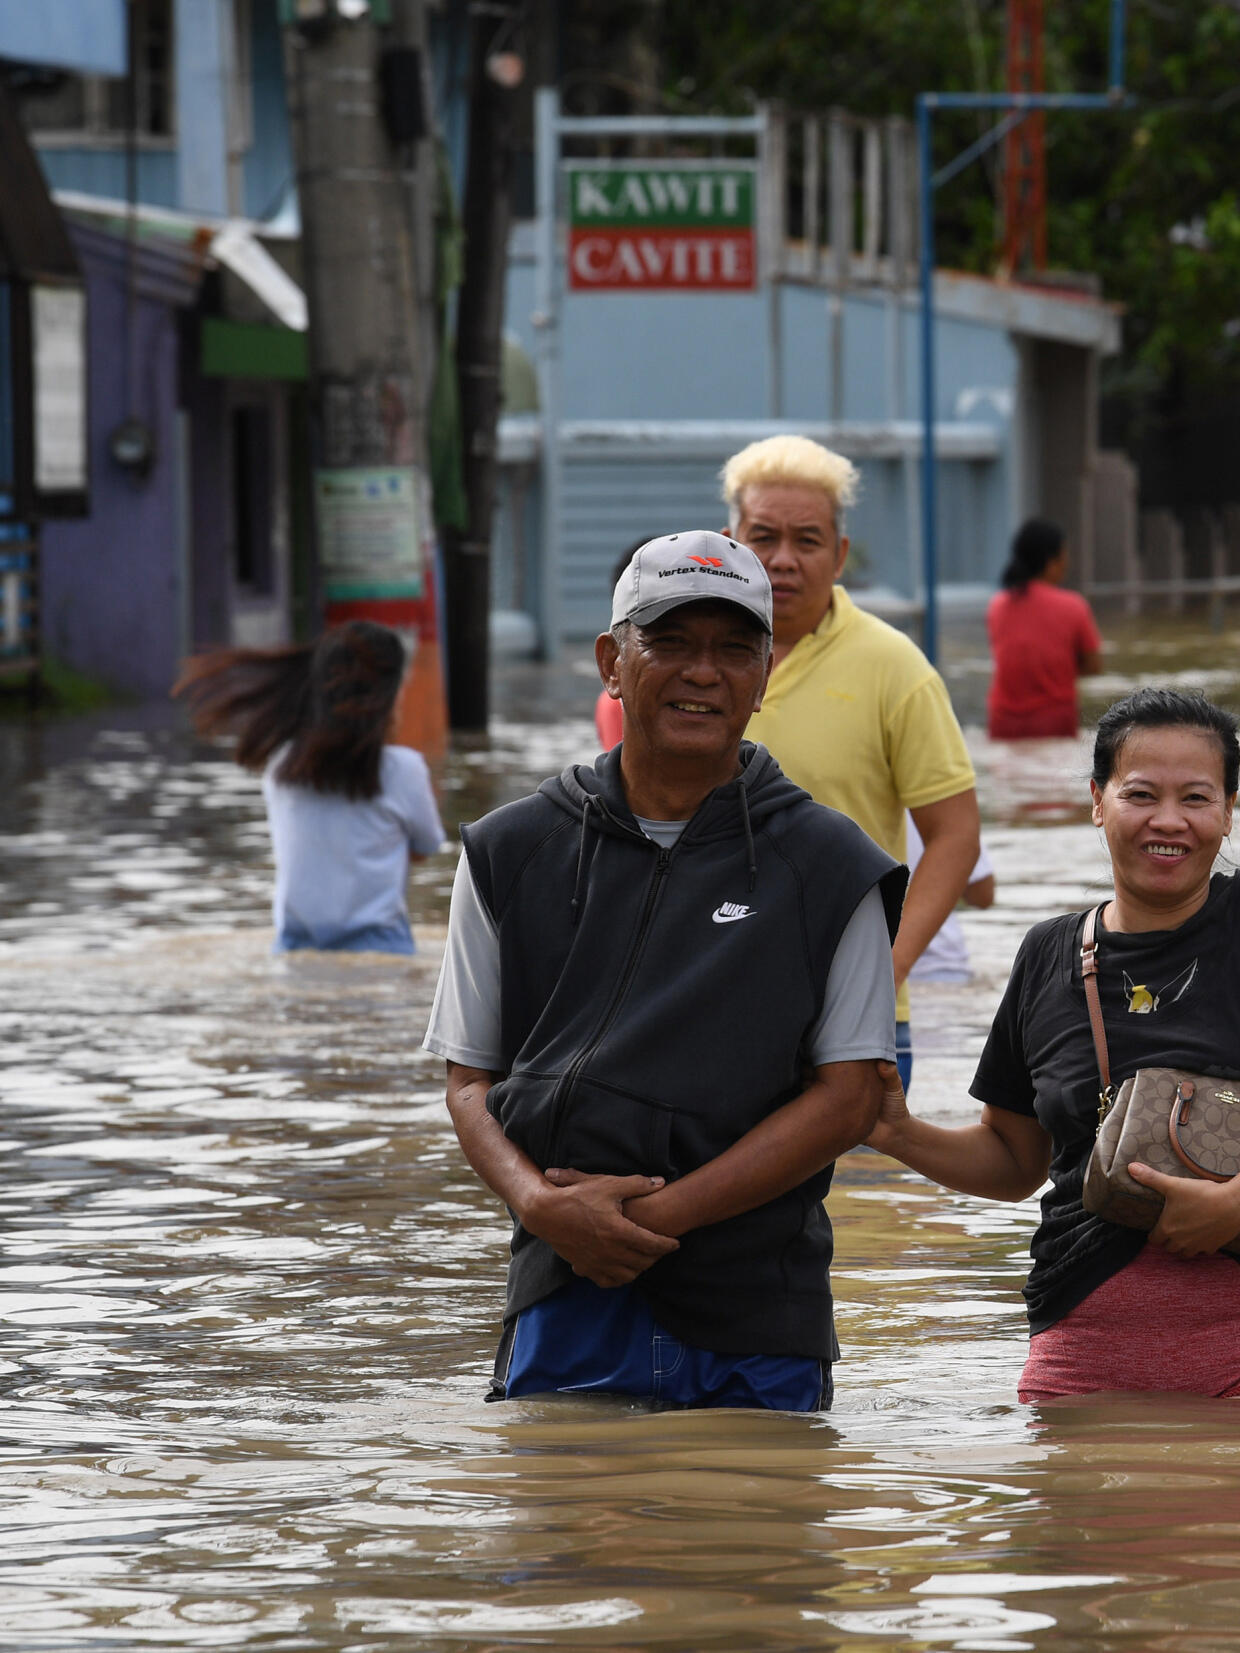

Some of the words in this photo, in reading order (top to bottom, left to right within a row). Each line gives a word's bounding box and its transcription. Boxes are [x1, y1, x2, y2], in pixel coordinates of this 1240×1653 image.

[576, 173, 745, 216] KAWIT
[574, 237, 750, 281] CAVITE
[658, 567, 697, 578] Vertex
[699, 567, 750, 583] Standard
[720, 902, 750, 917] NIKE
